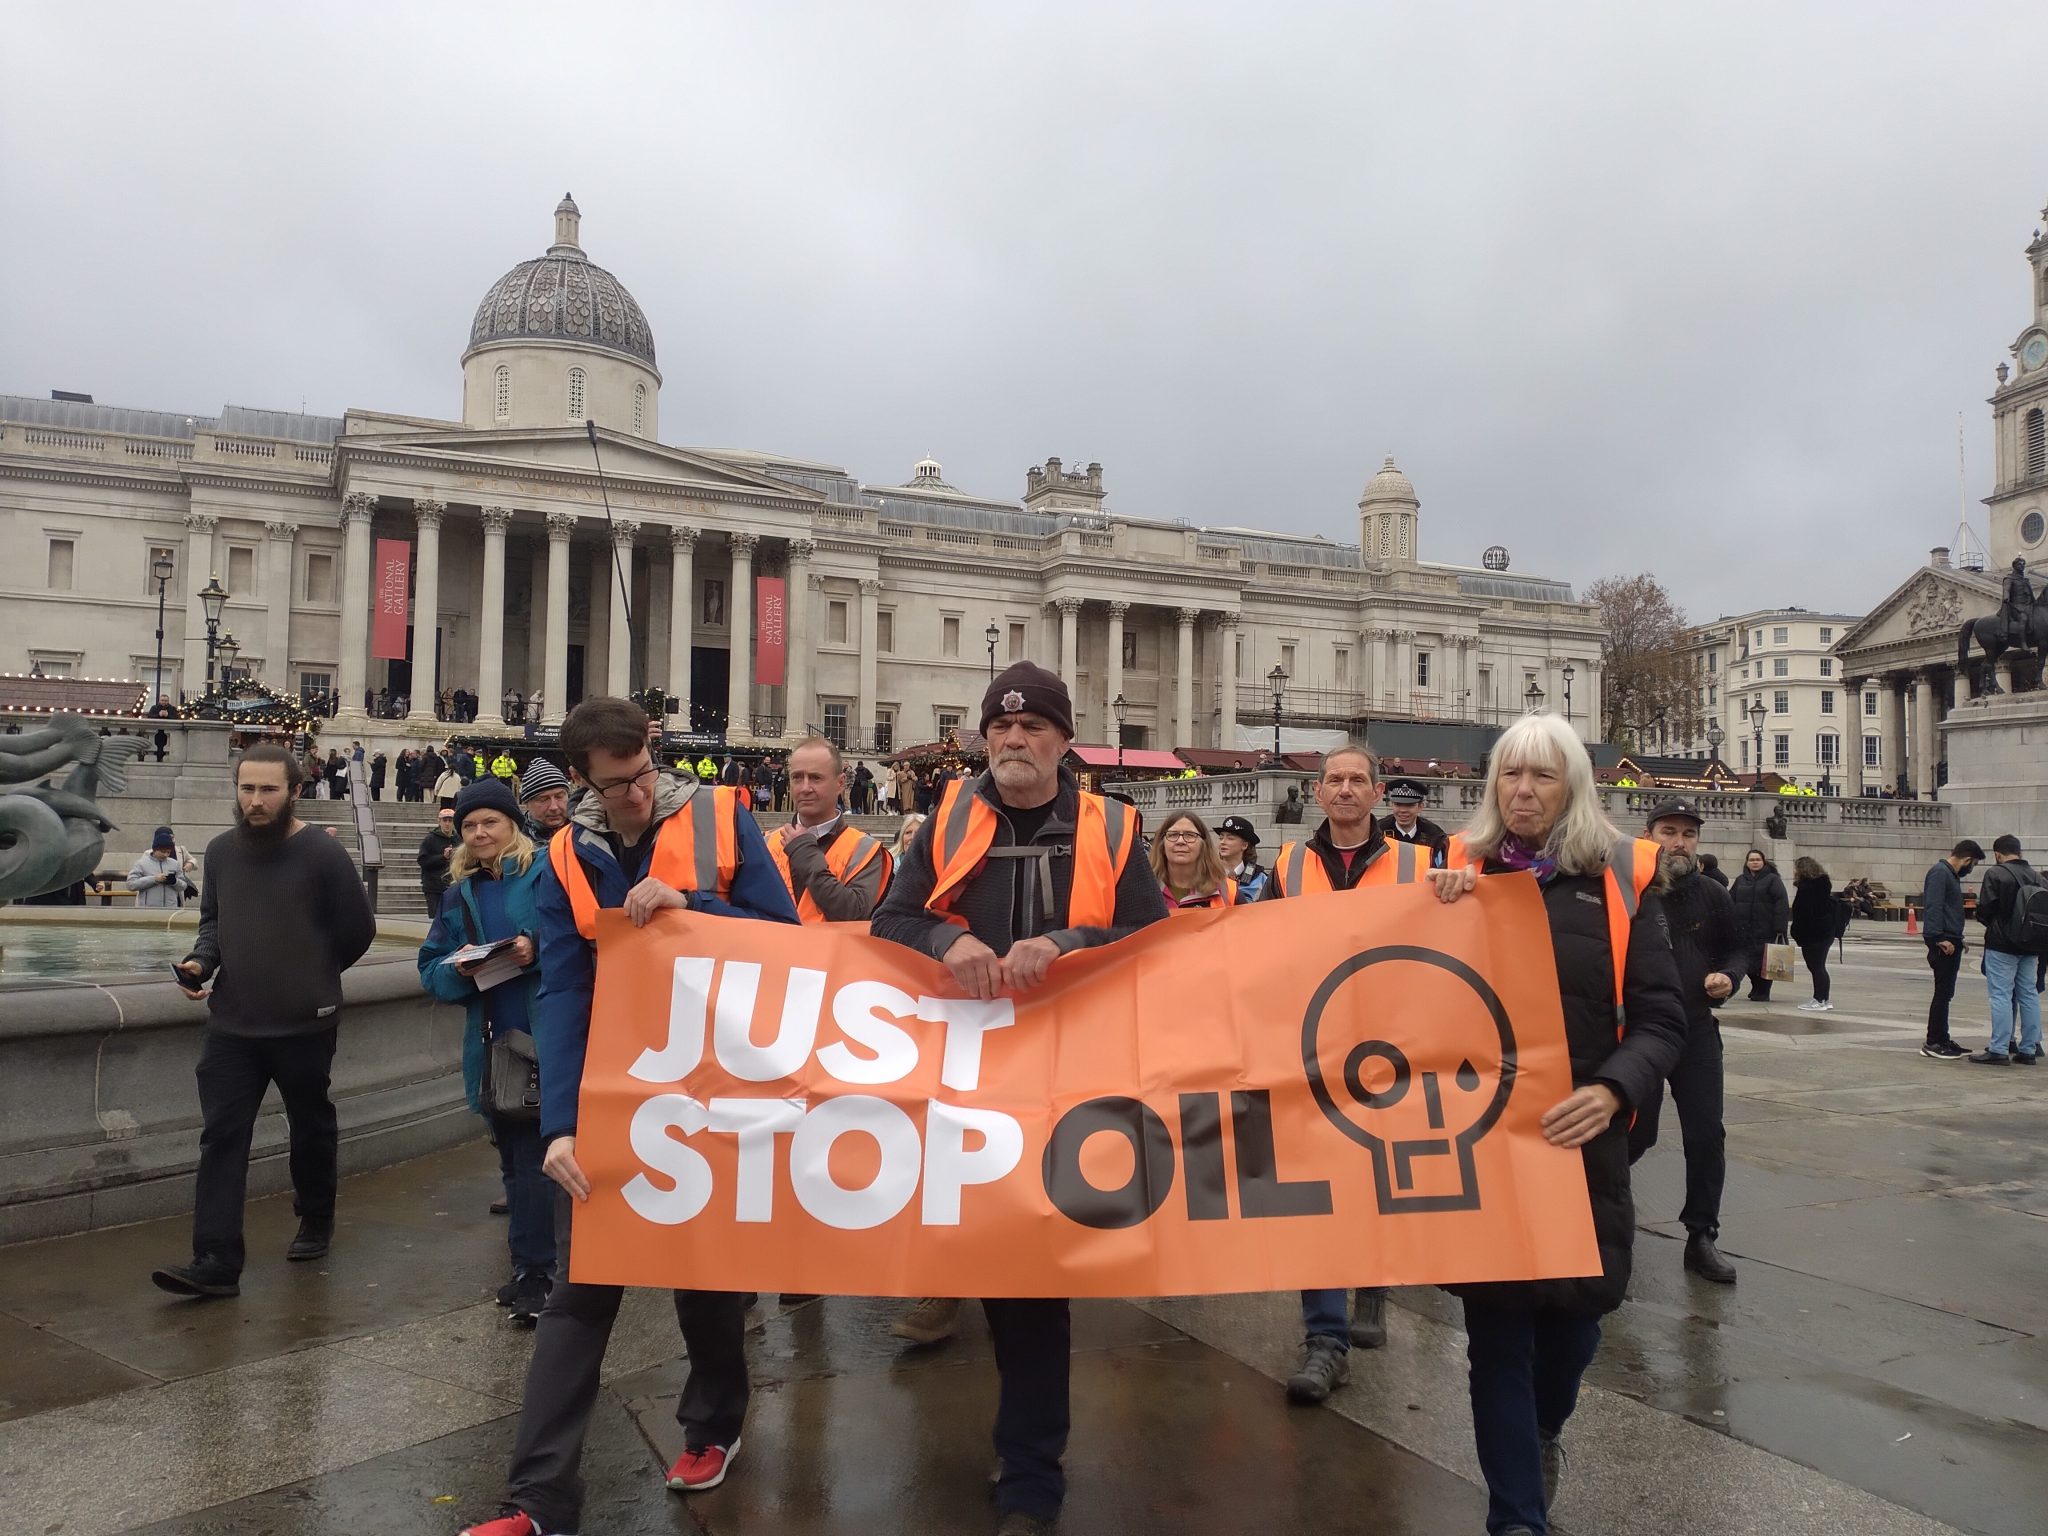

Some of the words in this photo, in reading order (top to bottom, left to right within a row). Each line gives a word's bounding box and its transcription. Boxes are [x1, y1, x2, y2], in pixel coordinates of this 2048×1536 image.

[384, 559, 395, 614] NATIONAL
[393, 559, 405, 615] GALLERY
[765, 594, 773, 644] NATIONAL
[773, 594, 782, 645] GALLERY
[628, 956, 1015, 1091] JUST
[621, 1093, 1024, 1229] STOP
[1042, 1089, 1333, 1229] OIL
